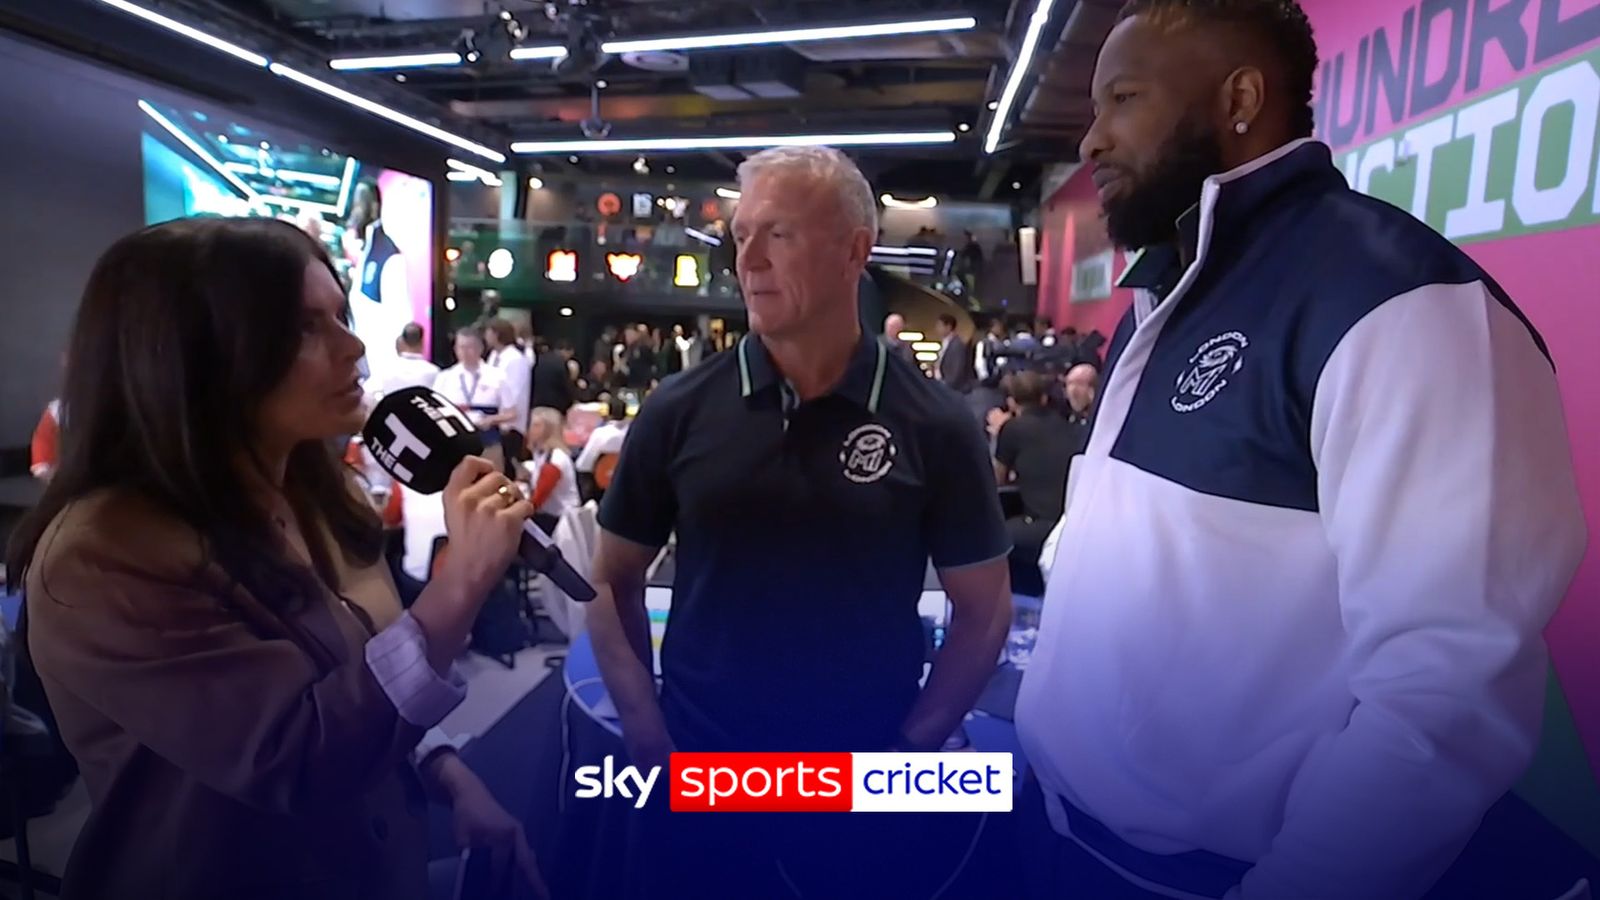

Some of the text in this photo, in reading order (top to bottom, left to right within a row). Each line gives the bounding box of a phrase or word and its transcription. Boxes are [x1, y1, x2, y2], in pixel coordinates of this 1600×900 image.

[1189, 331, 1248, 363] LONDON
[1171, 379, 1227, 412] LONDON
[371, 436, 397, 470] THE
